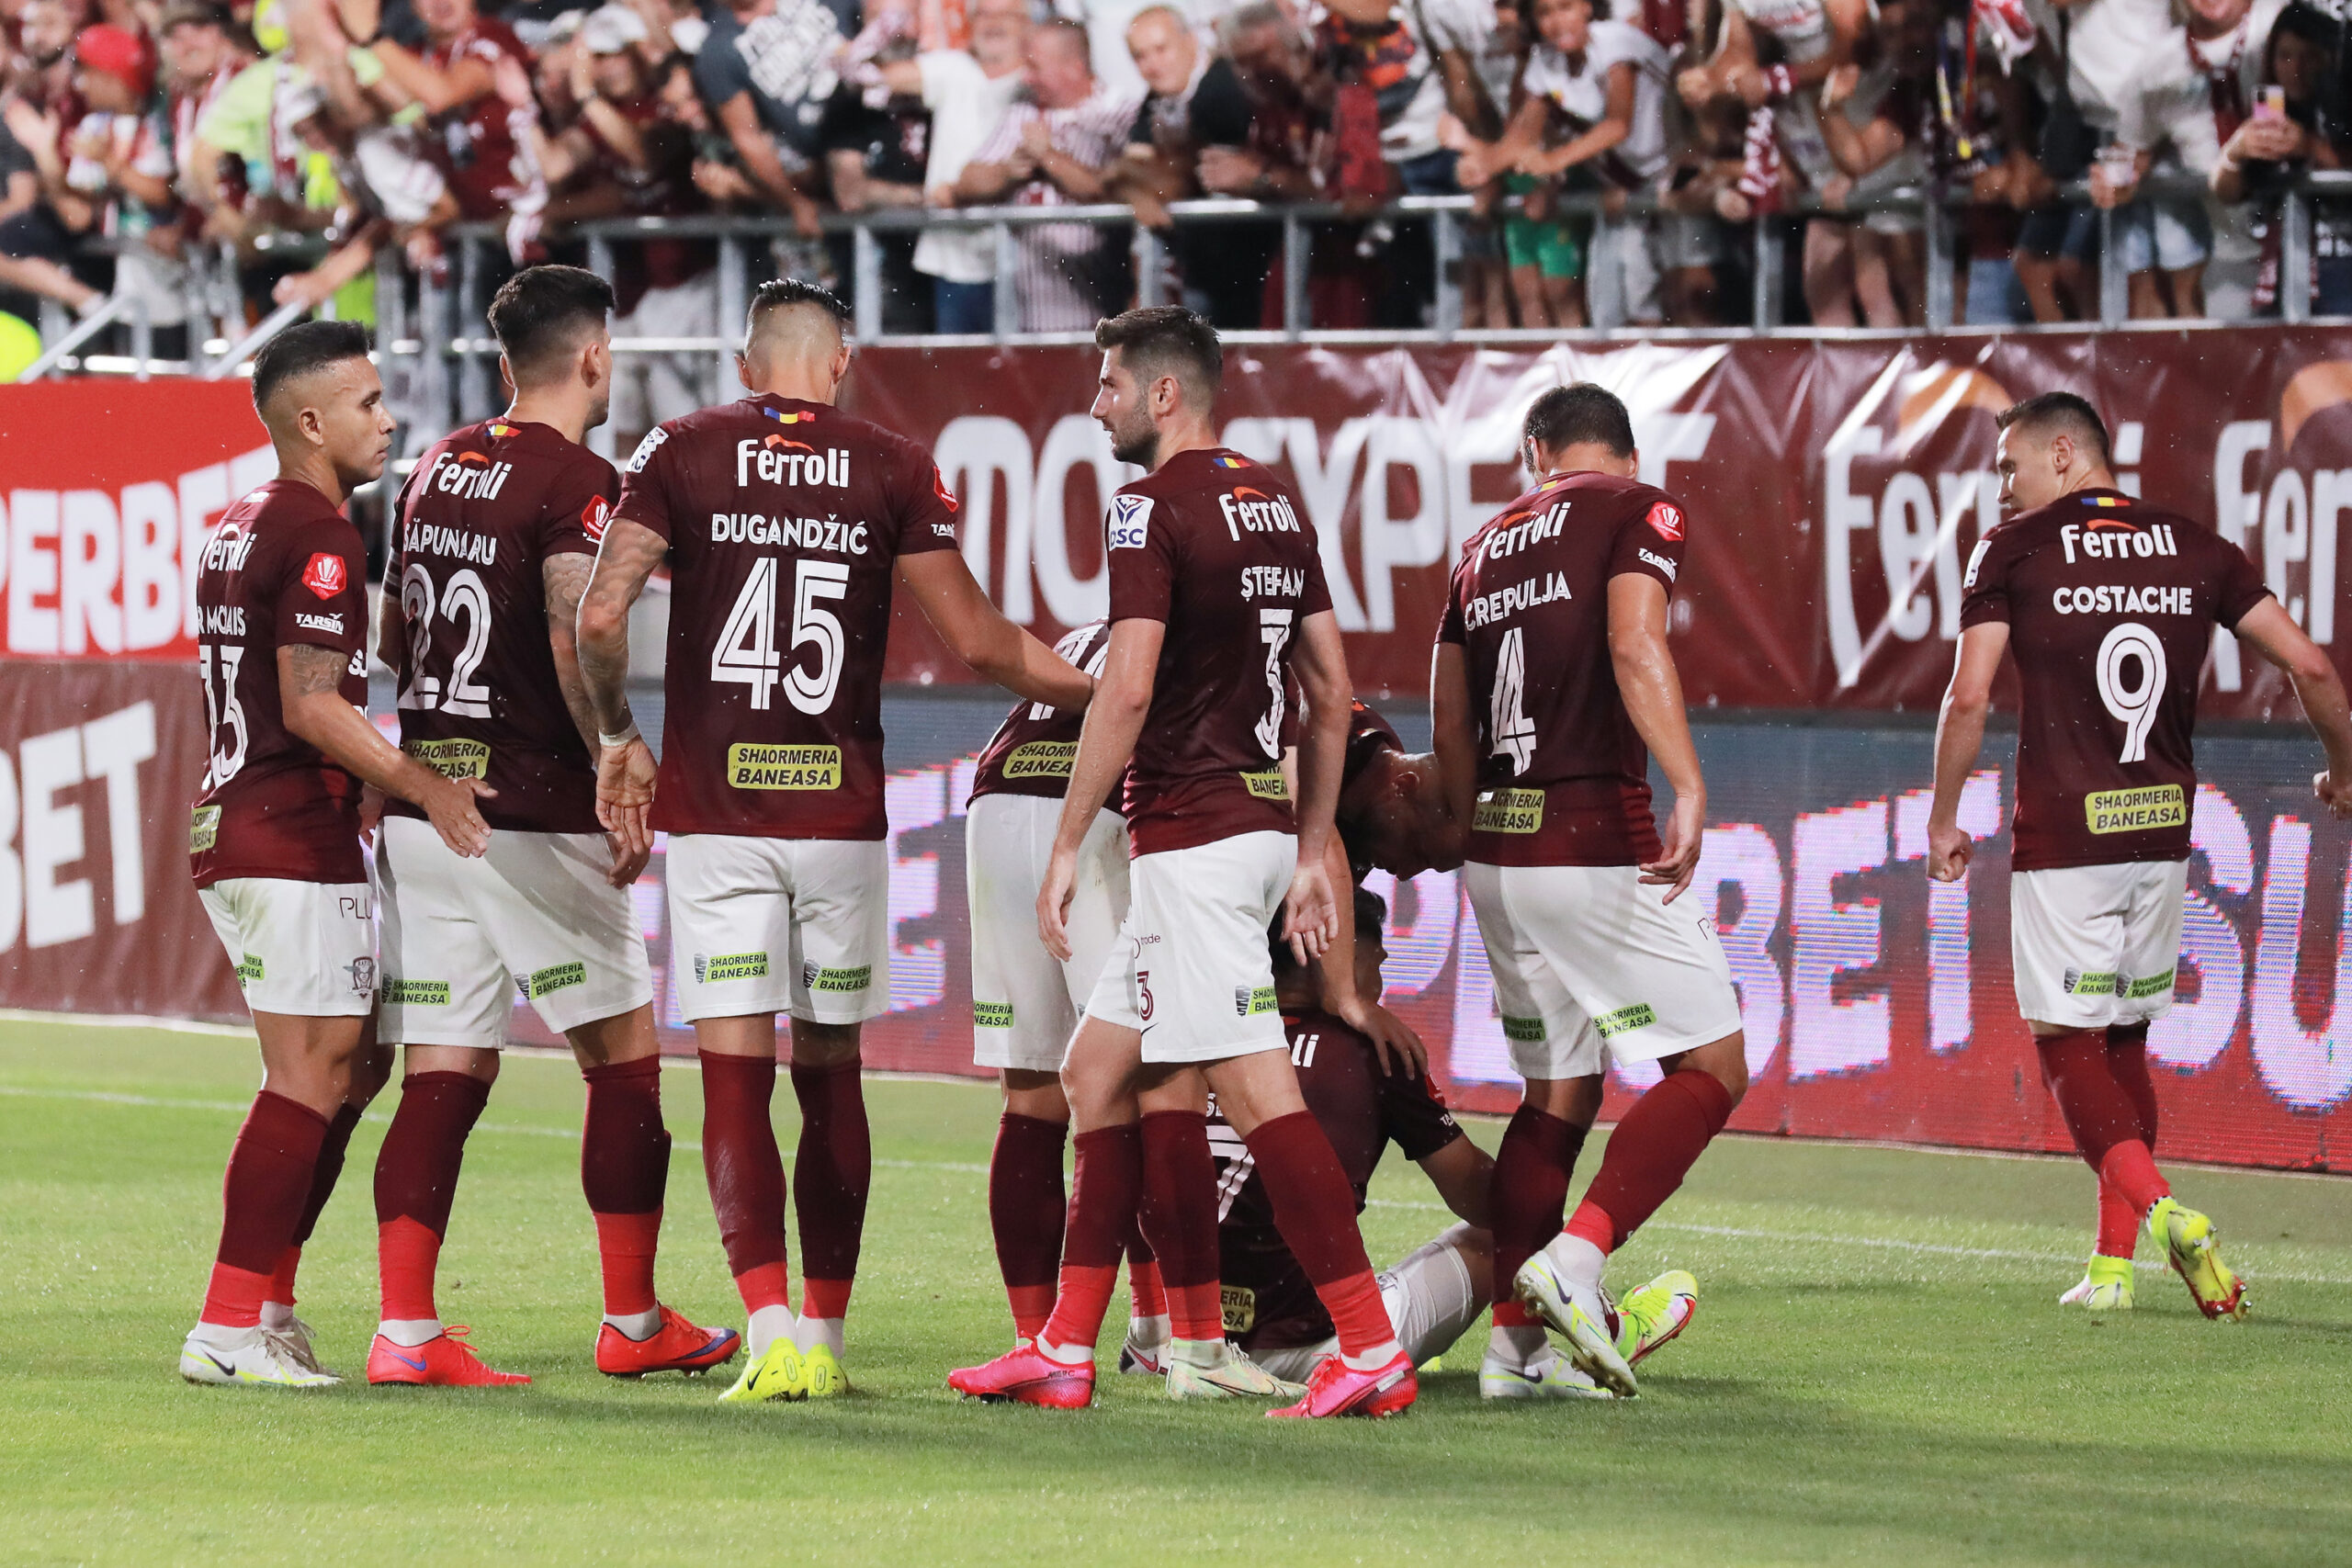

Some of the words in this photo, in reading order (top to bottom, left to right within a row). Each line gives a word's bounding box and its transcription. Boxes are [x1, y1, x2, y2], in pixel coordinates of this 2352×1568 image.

[421, 451, 513, 501] Ferroli
[737, 438, 850, 488] Ferroli
[1218, 492, 1302, 542] Ferroli
[711, 513, 868, 555] DUGANDŽIĆ
[1110, 528, 1145, 547] DSC
[1474, 502, 1572, 575] Ferroli
[2060, 524, 2177, 564] Ferroli
[0, 443, 279, 656] ERBE
[1464, 570, 1573, 631] CREPULJA
[2052, 585, 2193, 615] COSTACHE
[397, 563, 492, 719] 22
[710, 557, 851, 716] 45
[1254, 608, 1294, 761] 3
[2096, 622, 2167, 764] 9
[1490, 626, 1537, 777] 4
[738, 748, 838, 765] SHAORMERIA
[1017, 745, 1076, 758] SHAORM
[1009, 760, 1074, 774] BANEA
[2094, 788, 2182, 810] SHAORMERIA
[0, 699, 157, 955] ET
[2096, 807, 2182, 829] BANEASA
[532, 963, 584, 984] SHAORMERIA
[709, 951, 768, 968] SHAORMERIA
[711, 965, 766, 980] BANEASA
[392, 992, 446, 1005] BANEASA
[393, 981, 449, 992] SHAORMERIA
[536, 974, 583, 996] BANEASA
[1136, 970, 1154, 1021] 3
[975, 1003, 1012, 1015] ORMERIA
[1594, 1003, 1651, 1028] SHAORMERIA
[1600, 1015, 1653, 1038] BANEASA
